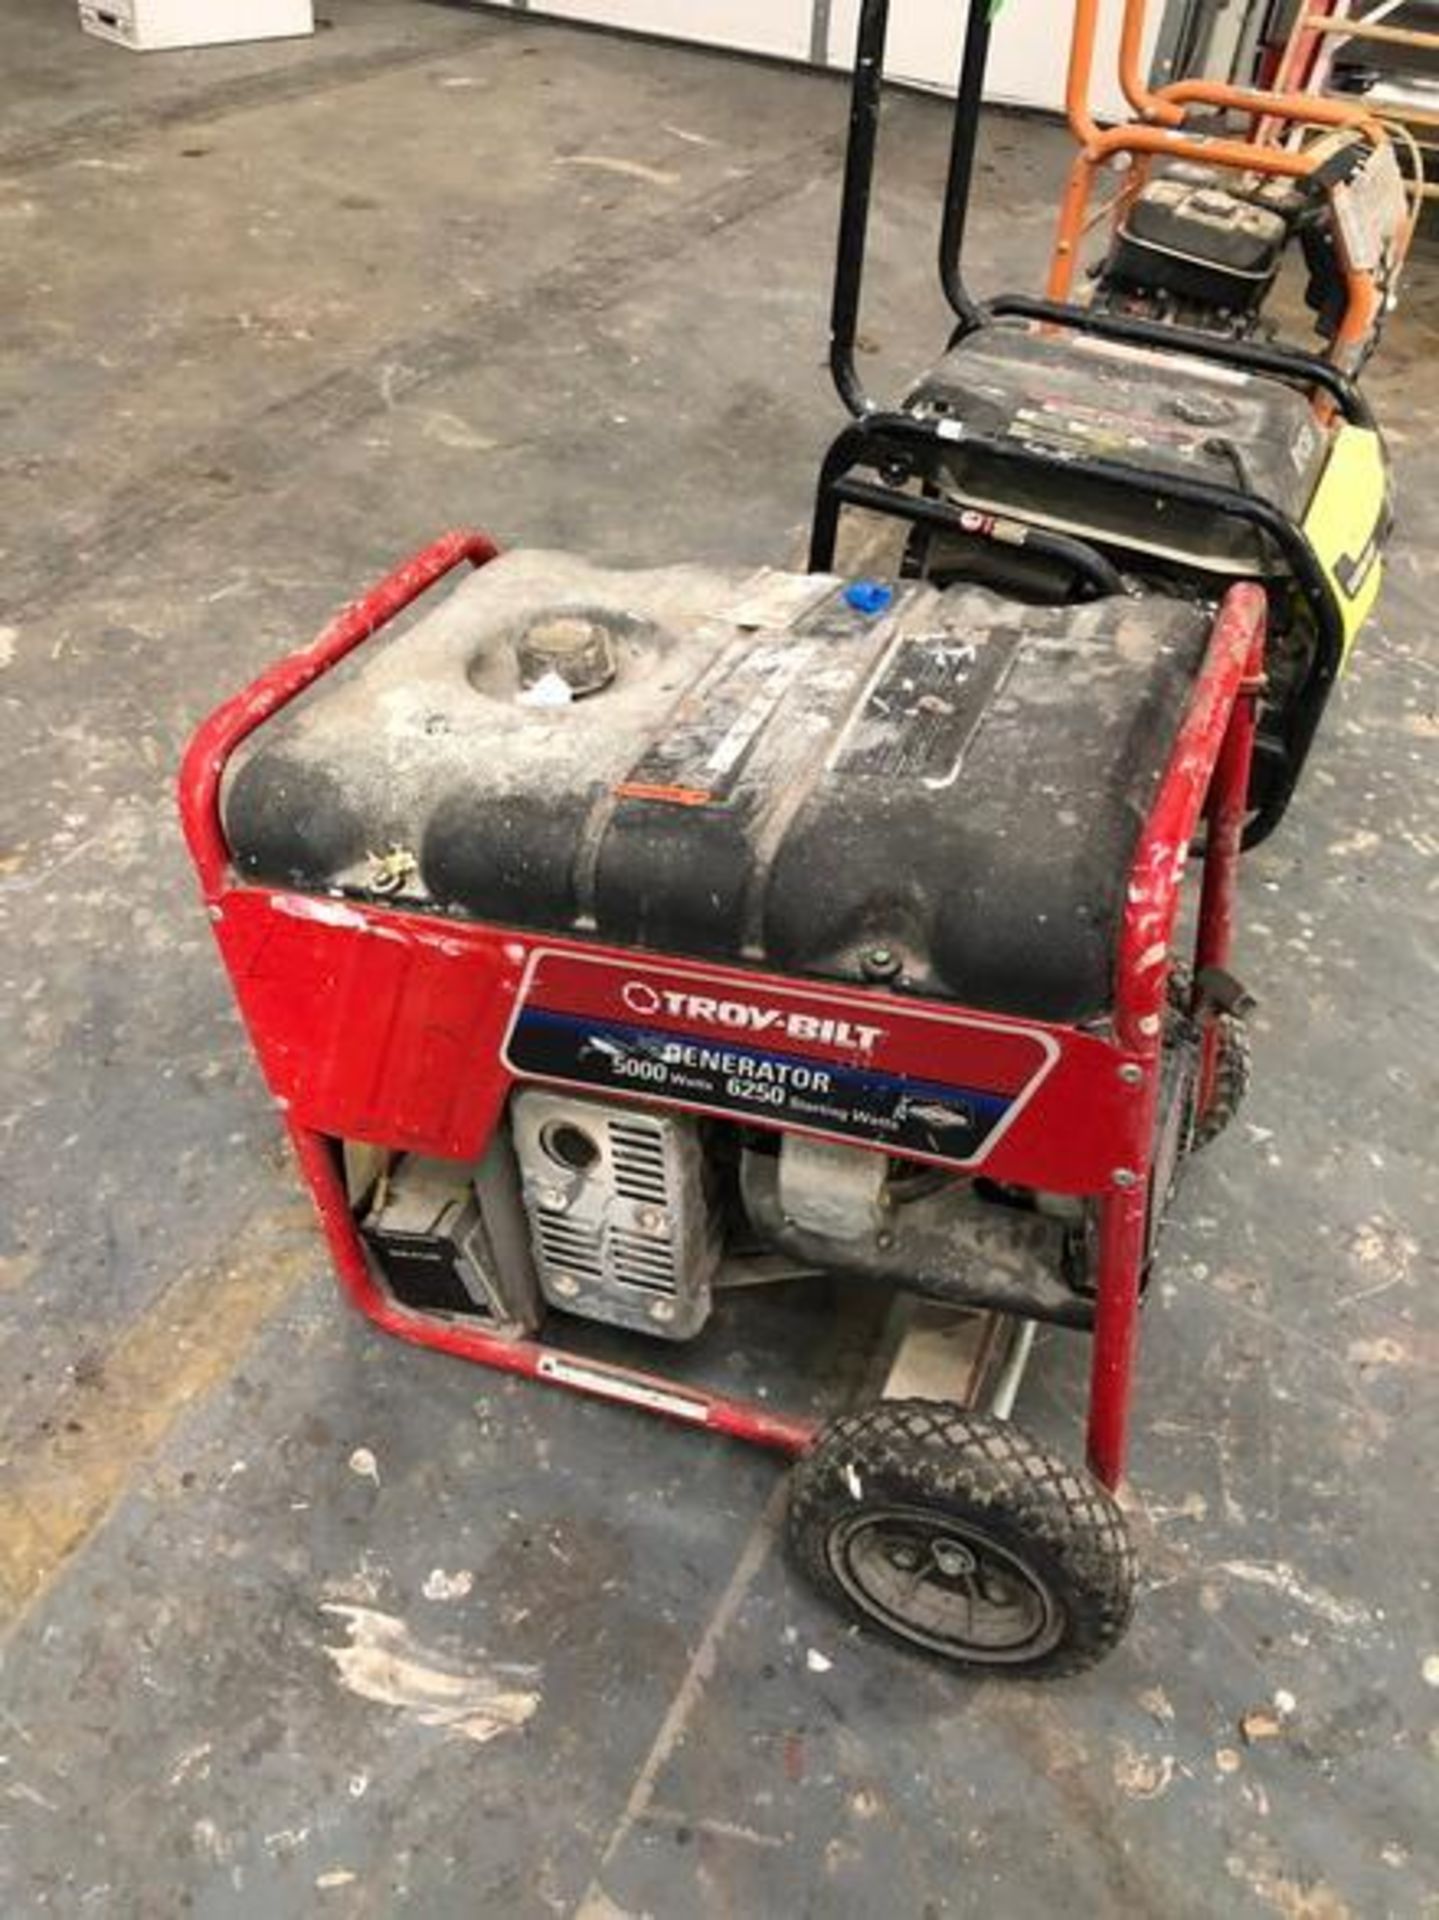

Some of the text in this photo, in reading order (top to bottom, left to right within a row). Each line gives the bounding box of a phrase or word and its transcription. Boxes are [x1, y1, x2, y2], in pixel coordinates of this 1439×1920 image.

[662, 991, 883, 1050] TROY-BILT
[612, 1056, 667, 1082] 5000
[670, 1073, 714, 1091] Watts
[727, 1079, 785, 1106] 6250
[789, 1096, 848, 1121] Starting
[850, 1107, 899, 1131] Watts
